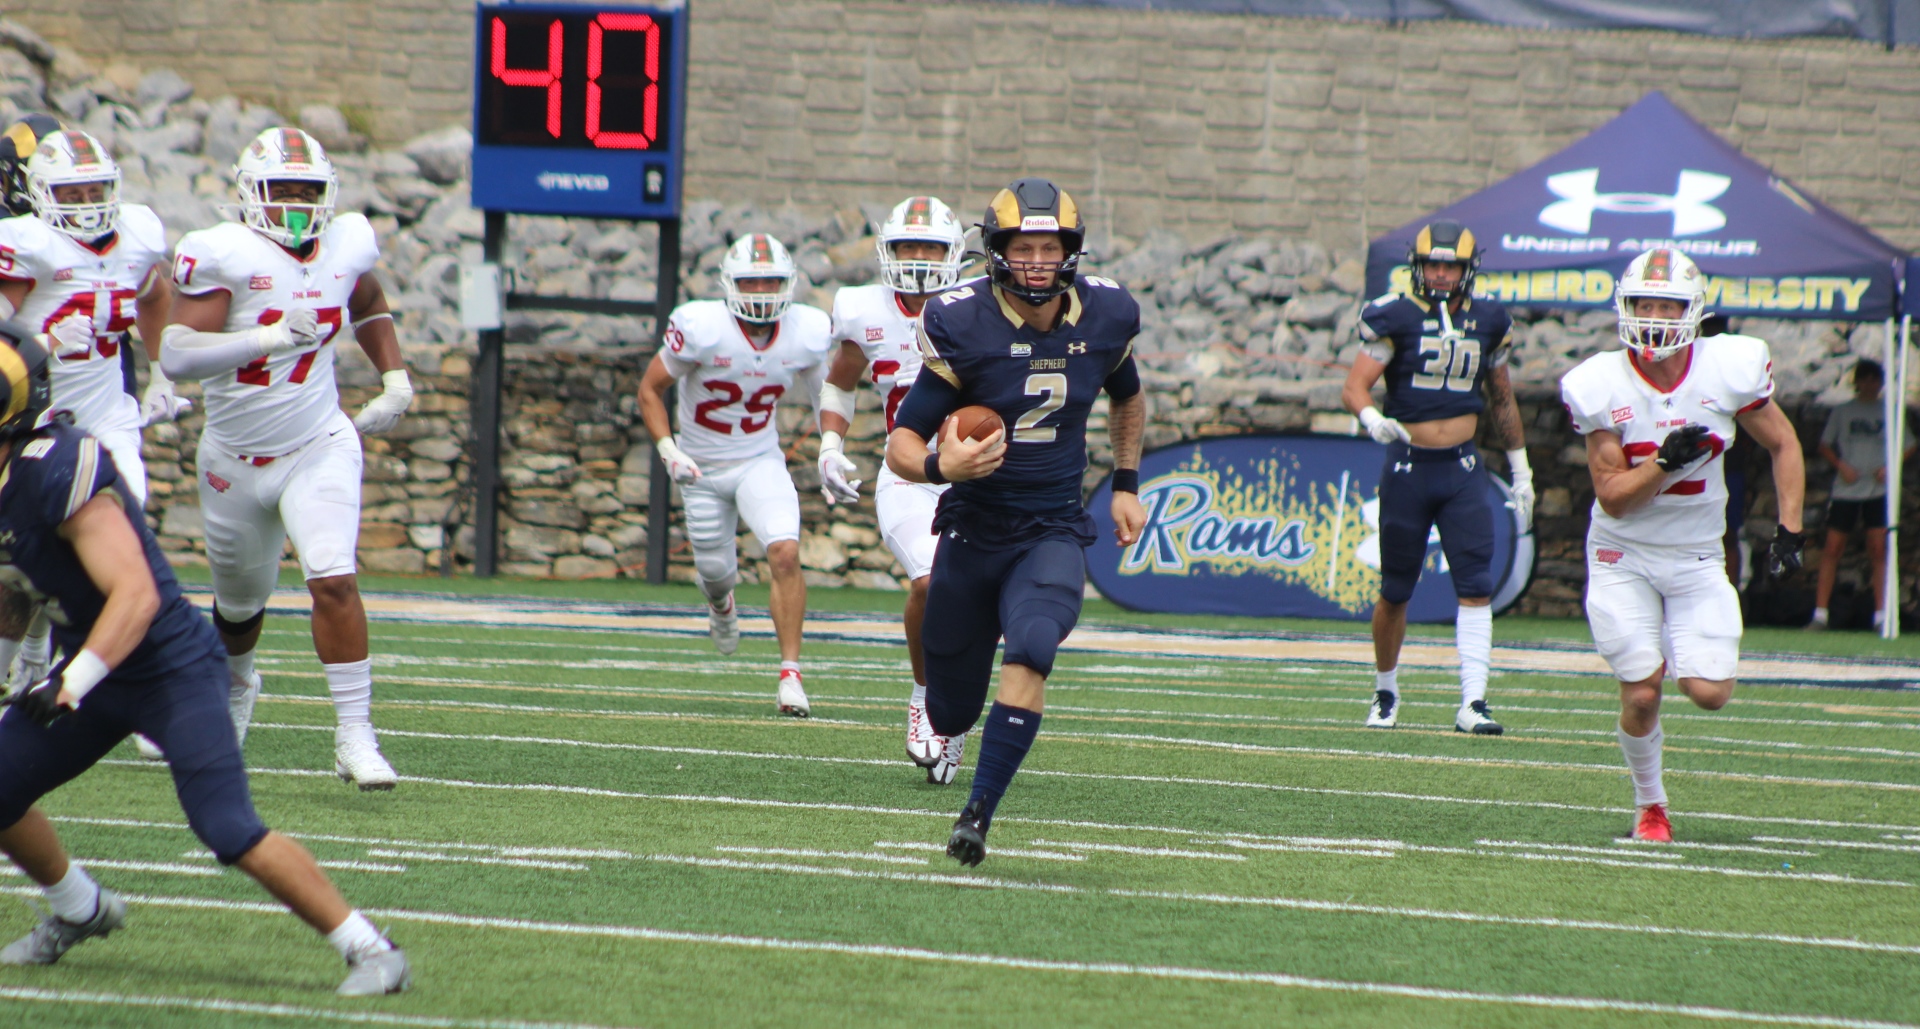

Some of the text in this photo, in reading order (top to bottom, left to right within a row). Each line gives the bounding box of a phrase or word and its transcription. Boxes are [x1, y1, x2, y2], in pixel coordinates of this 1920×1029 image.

[491, 13, 660, 149] 40
[1502, 234, 1757, 255] UNDER ARMOUR
[1389, 265, 1614, 304] SPHERD
[1029, 358, 1066, 370] SHEPHERD
[1411, 335, 1481, 392] 30
[694, 380, 785, 434] 29
[1012, 373, 1067, 442] 2
[1118, 472, 1317, 574] Rams
